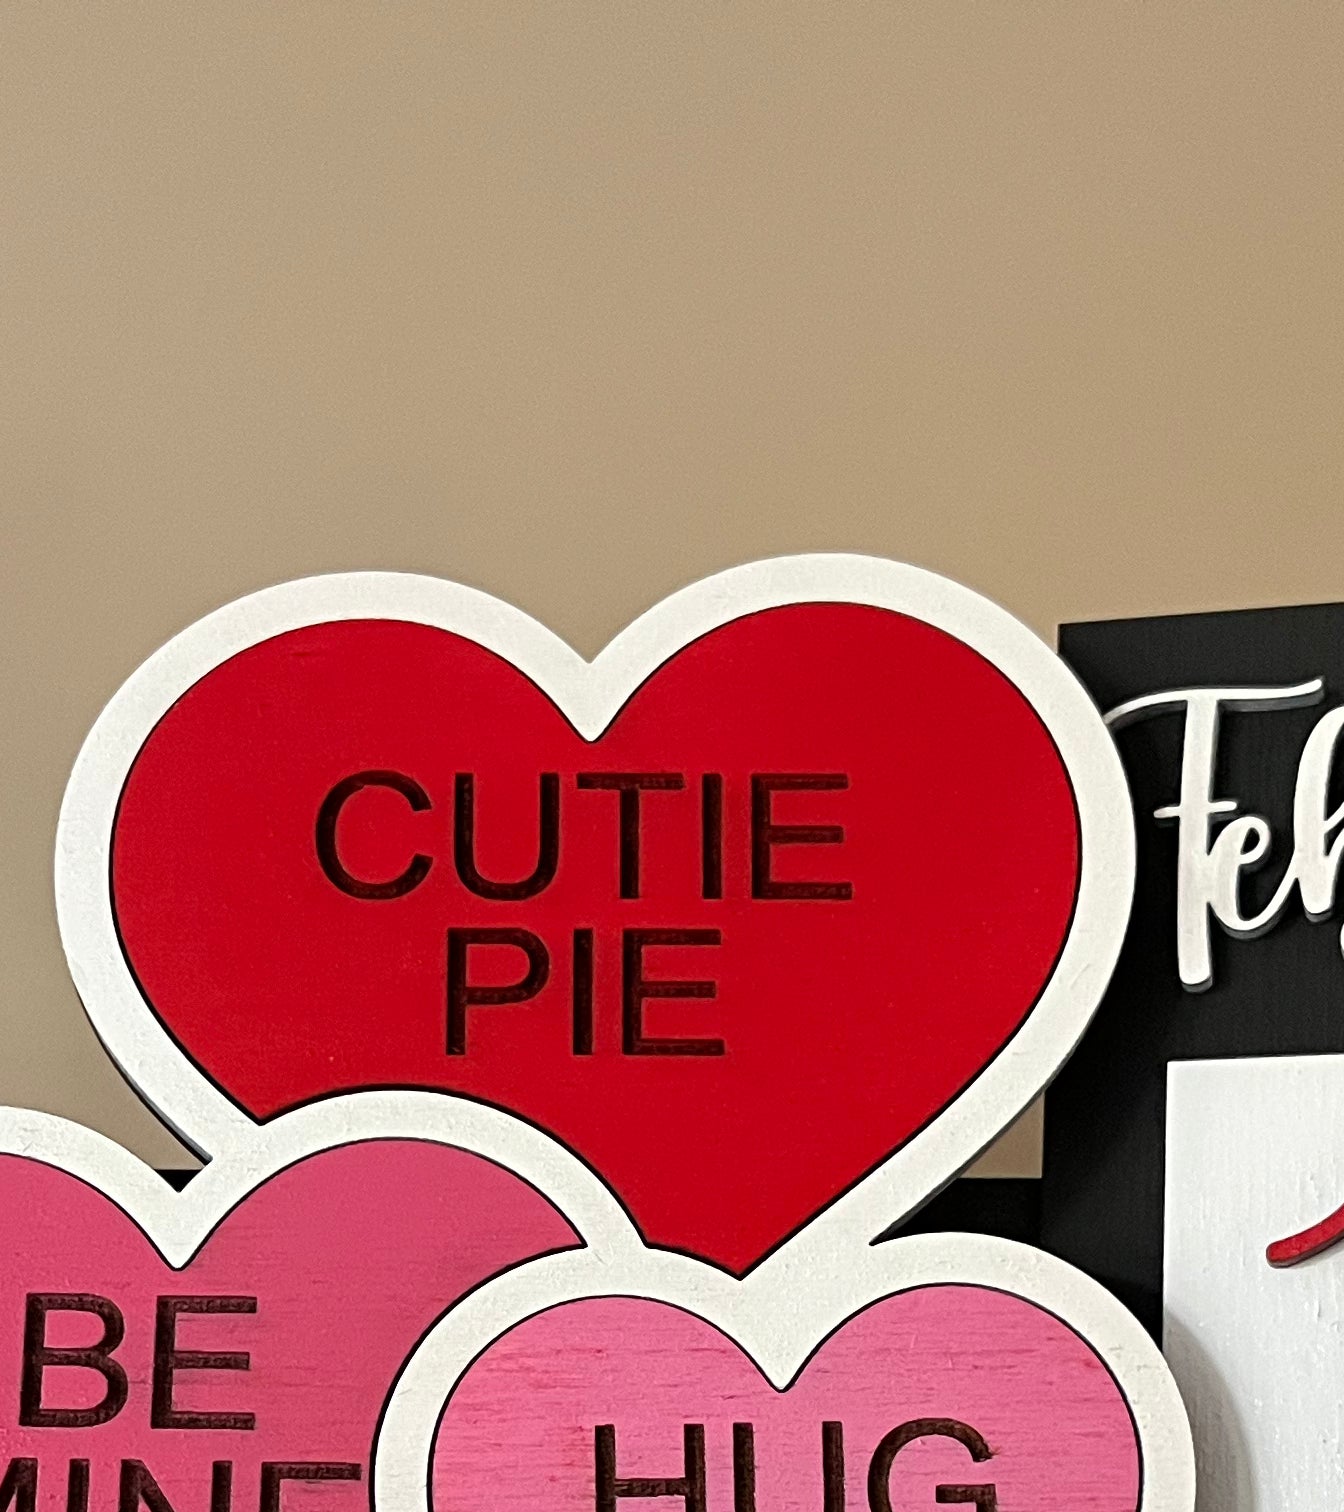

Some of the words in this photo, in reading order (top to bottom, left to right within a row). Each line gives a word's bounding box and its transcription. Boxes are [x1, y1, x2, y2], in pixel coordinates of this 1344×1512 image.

[314, 769, 855, 903] CUTIE
[443, 925, 726, 1058] PIE
[16, 1291, 258, 1431] BE
